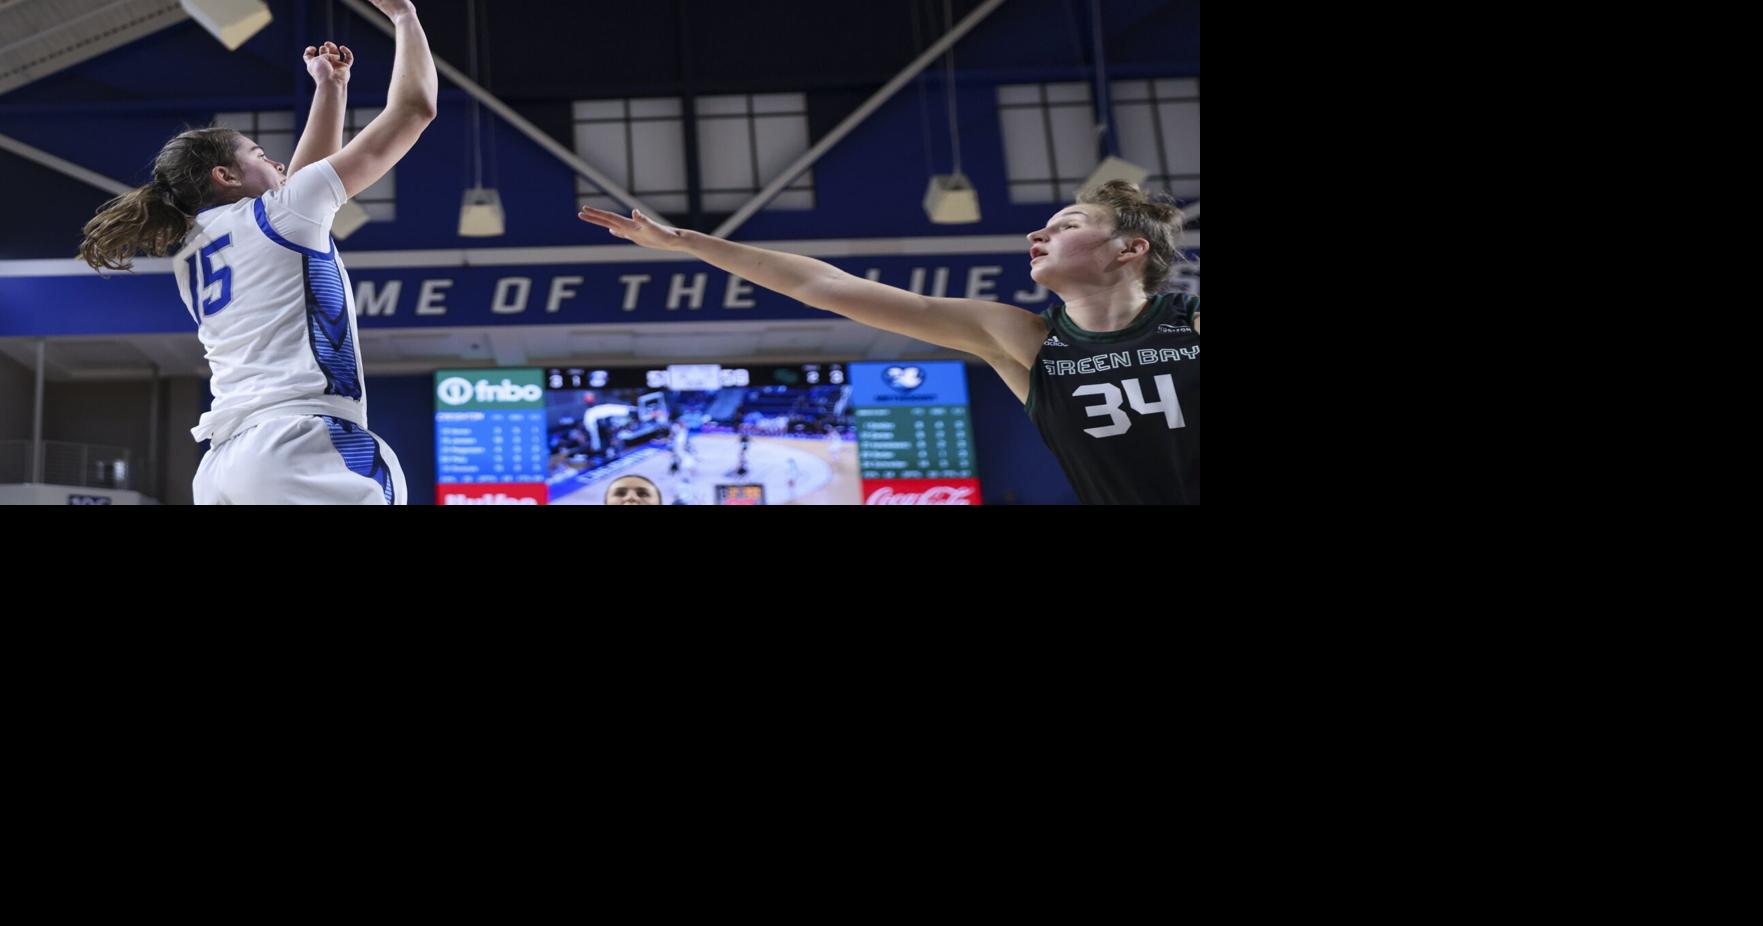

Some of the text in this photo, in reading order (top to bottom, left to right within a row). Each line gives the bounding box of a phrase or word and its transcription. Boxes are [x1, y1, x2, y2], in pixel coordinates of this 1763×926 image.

[185, 231, 233, 325] 15
[356, 279, 454, 316] ME
[491, 276, 584, 314] OF
[618, 273, 757, 312] THE
[1042, 345, 1200, 375] GREEN BAY
[475, 379, 543, 402] fnbo
[1072, 373, 1186, 438] 34
